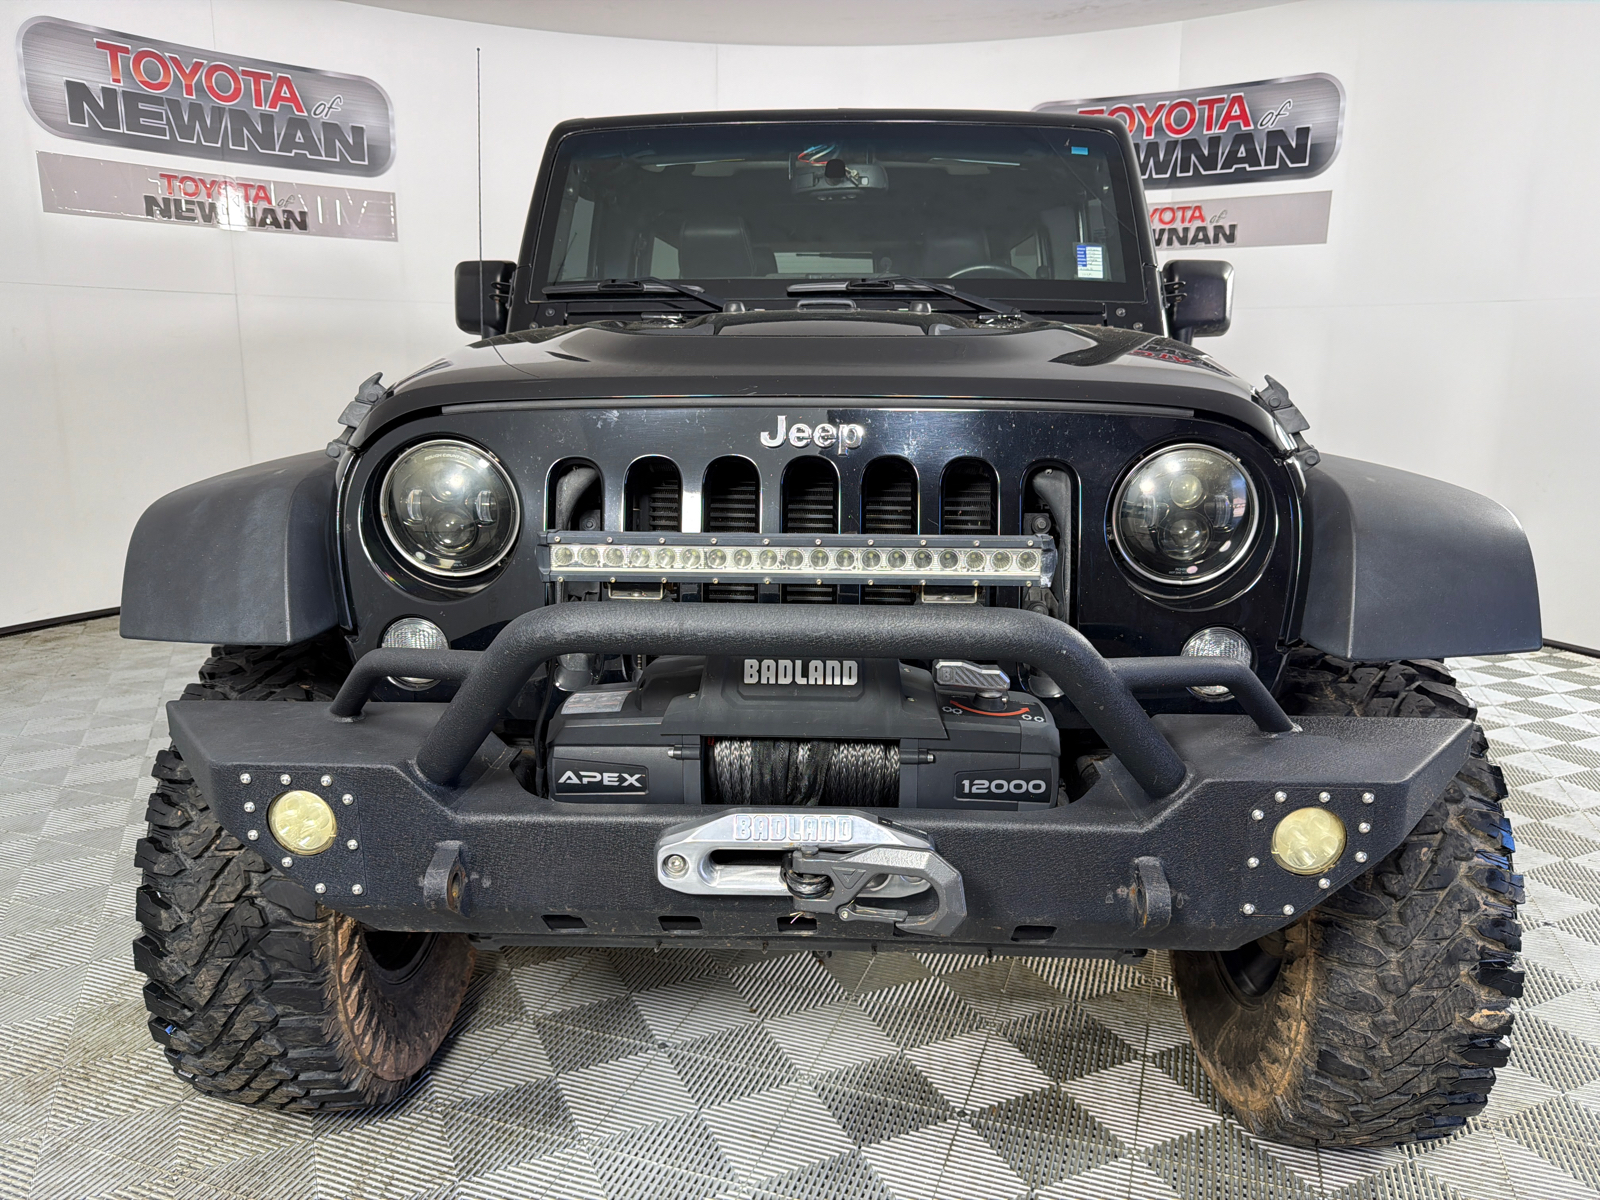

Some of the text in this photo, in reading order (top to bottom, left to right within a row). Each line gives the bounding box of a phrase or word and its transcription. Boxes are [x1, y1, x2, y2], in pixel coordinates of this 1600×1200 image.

[94, 38, 343, 119] TOYOTA of
[64, 79, 369, 165] NEWNAN
[1258, 99, 1293, 129] of
[1134, 125, 1313, 179] WNAN
[277, 194, 296, 208] of
[1149, 205, 1228, 226] YOTA of
[759, 415, 864, 457] Jeep
[743, 658, 858, 686] BADLAND
[557, 770, 643, 787] APEX
[961, 779, 1046, 794] 12000
[735, 814, 854, 842] BADLAND
